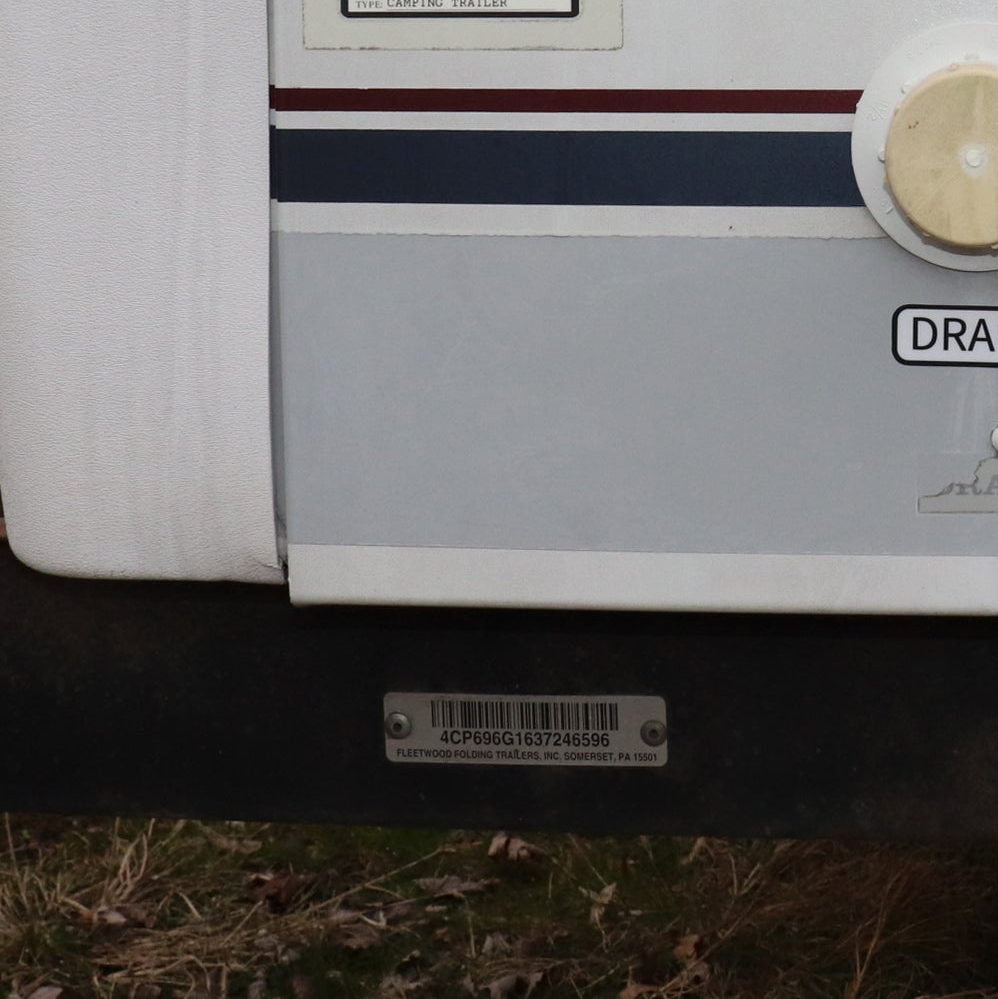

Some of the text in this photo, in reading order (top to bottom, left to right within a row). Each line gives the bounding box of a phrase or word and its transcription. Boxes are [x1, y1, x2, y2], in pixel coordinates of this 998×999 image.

[440, 730, 610, 747] 4CP696G1637246596
[396, 748, 452, 758] FLEETWOOD
[454, 750, 493, 759] FOLDING
[618, 753, 631, 761] PA
[634, 753, 657, 761] 15501
